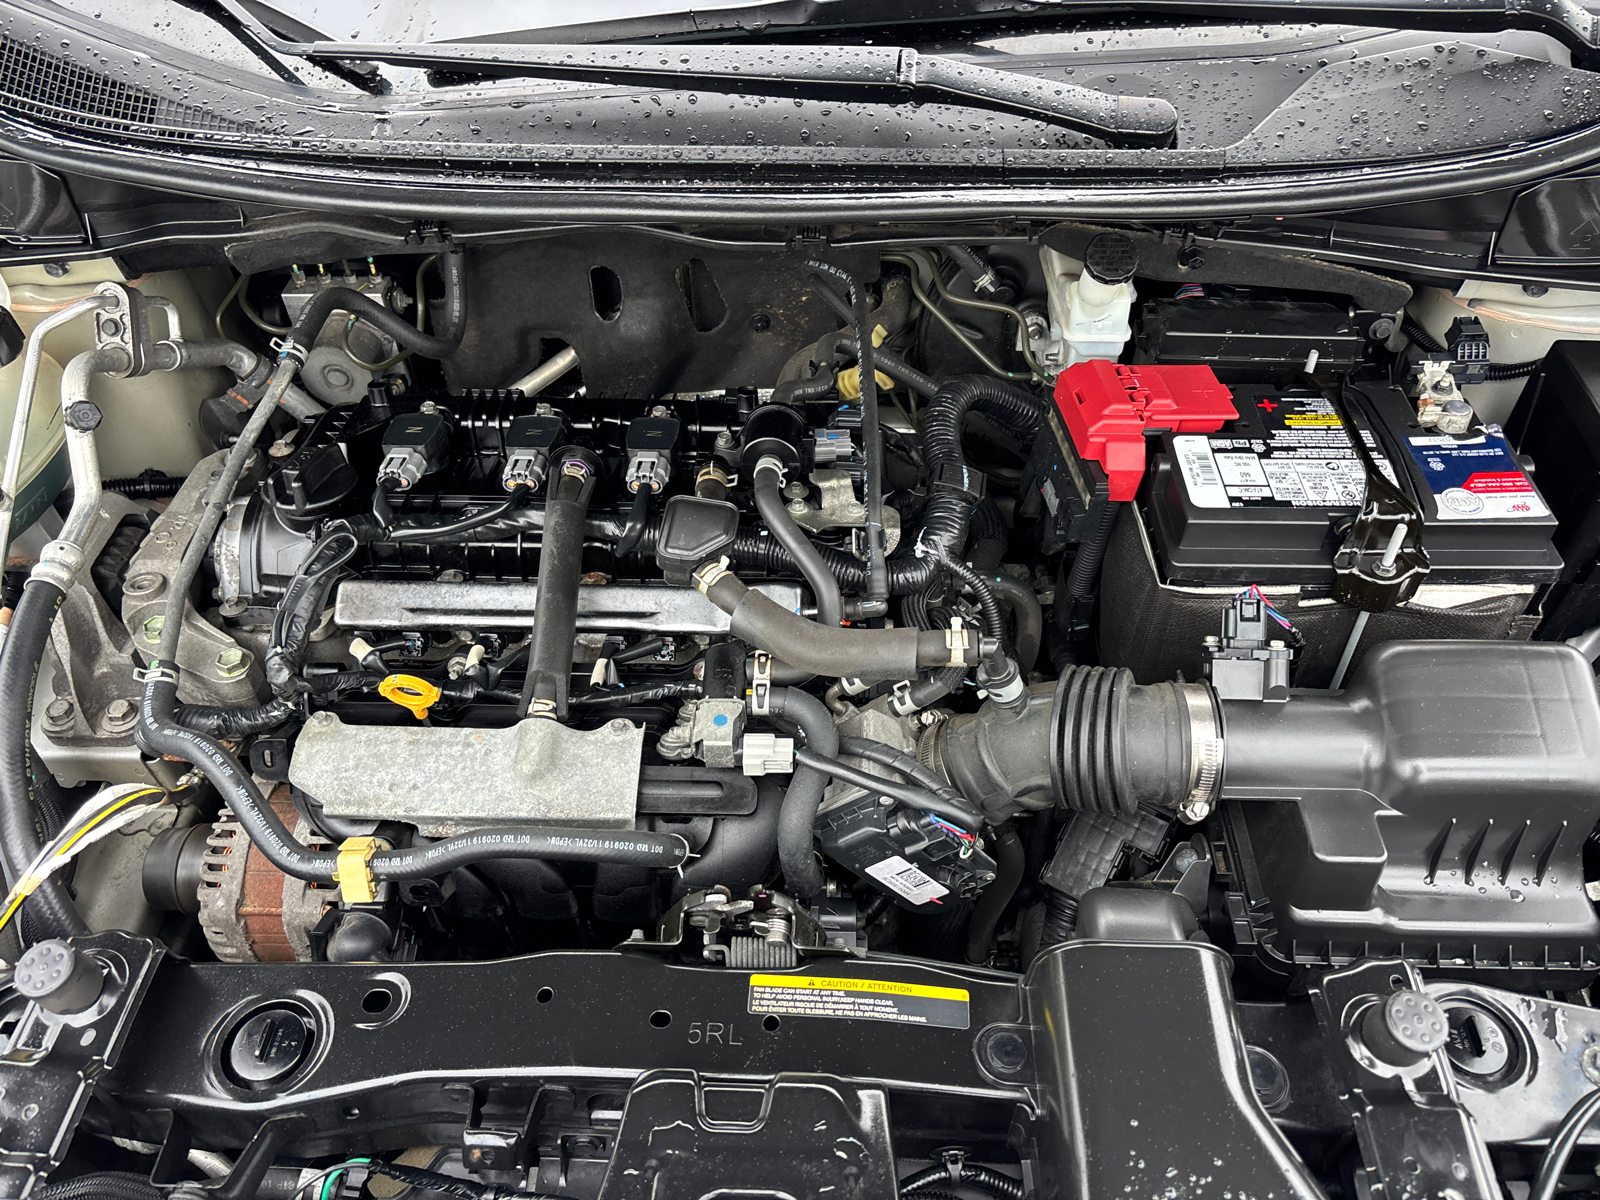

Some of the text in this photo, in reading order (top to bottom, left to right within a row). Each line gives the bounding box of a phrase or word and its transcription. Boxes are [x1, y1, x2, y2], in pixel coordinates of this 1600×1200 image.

[194, 738, 216, 755] 020919
[220, 764, 233, 776] DOT
[264, 829, 282, 849] 020919
[473, 835, 500, 844] 020919
[604, 840, 634, 850] 020919
[650, 845, 663, 854] DOT
[288, 852, 300, 863] DOT
[401, 856, 412, 865] DOT
[821, 980, 858, 988] CAUTION
[867, 983, 912, 993] ATTENTION
[688, 1022, 742, 1046] 5RL
